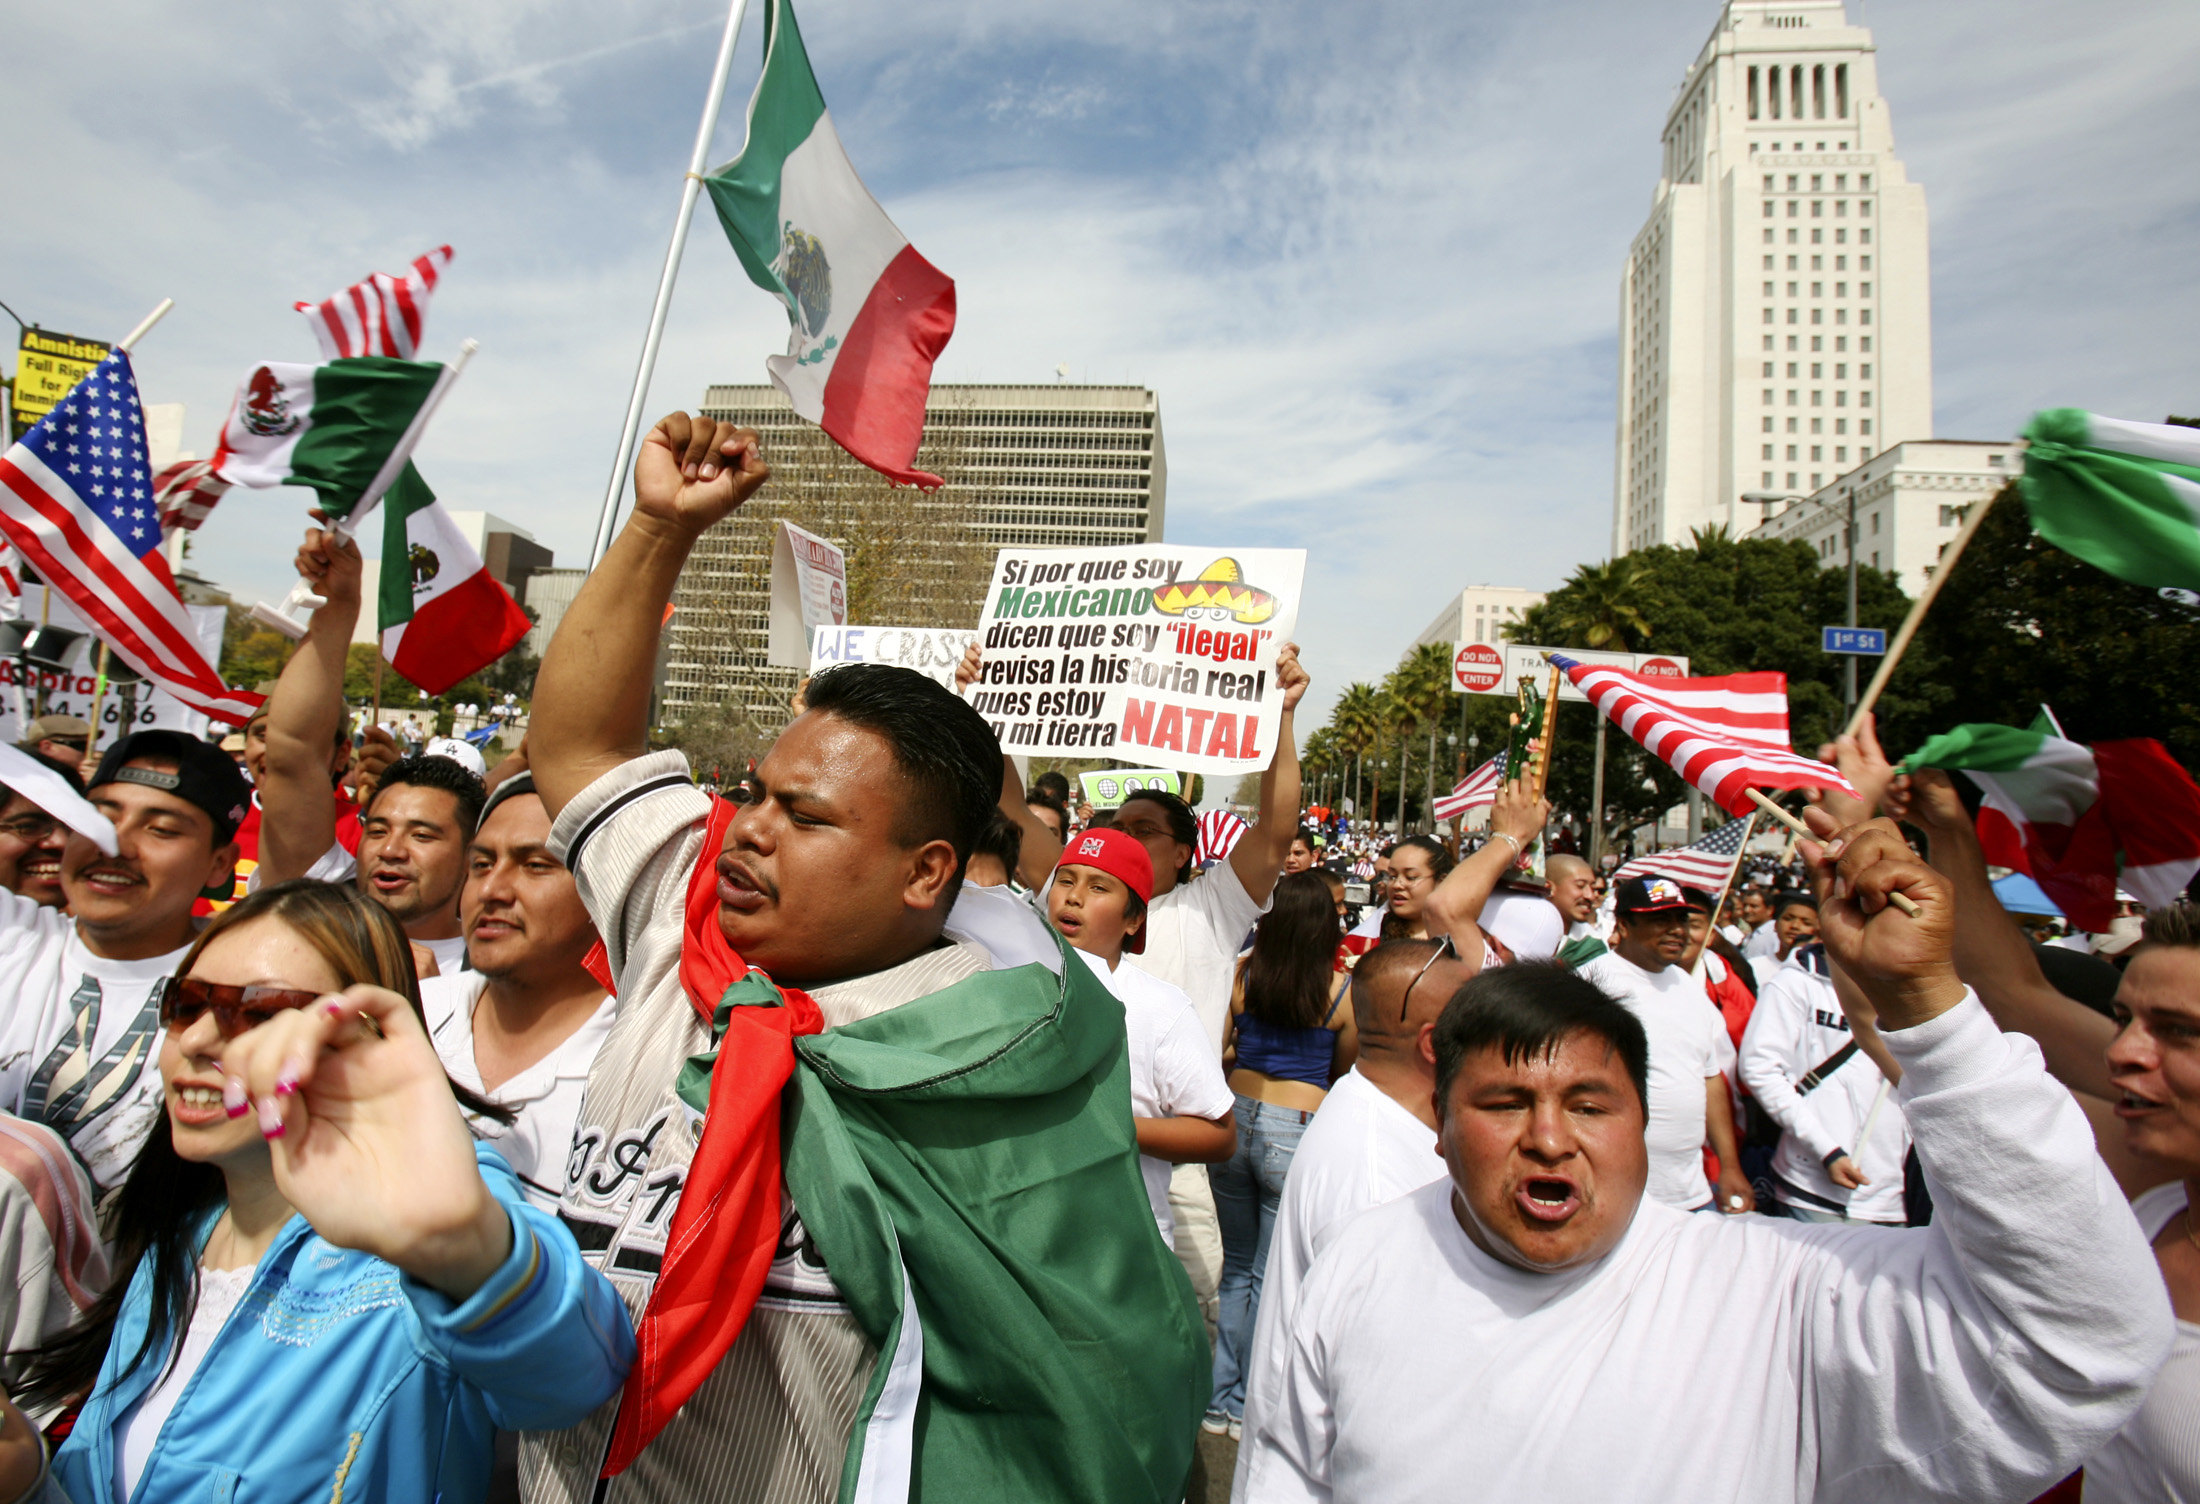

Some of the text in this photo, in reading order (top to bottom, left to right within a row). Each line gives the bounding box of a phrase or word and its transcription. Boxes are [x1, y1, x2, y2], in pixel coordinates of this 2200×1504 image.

[23, 332, 109, 361] Amnistia
[26, 357, 53, 373] Full
[41, 378, 61, 392] for
[1001, 558, 1183, 586] Si por que soy
[993, 584, 1156, 619] Mexicano
[818, 630, 864, 661] WE
[985, 622, 1054, 649] dicen
[1057, 624, 1106, 650] que
[1111, 623, 1160, 652] soy
[1834, 632, 1875, 648] 1st St
[1462, 651, 1497, 663] DO NOT
[1644, 665, 1679, 676] DO NOT
[979, 655, 1054, 685] revisa
[1059, 654, 1084, 684] la
[1089, 653, 1199, 695] historia
[1205, 670, 1266, 702] real
[1463, 674, 1494, 685] ENTER
[972, 688, 1106, 719] pues estoy
[1008, 719, 1044, 746] mi
[1046, 719, 1118, 747] tierra
[1120, 697, 1261, 759] NATAL
[444, 742, 458, 755] LA
